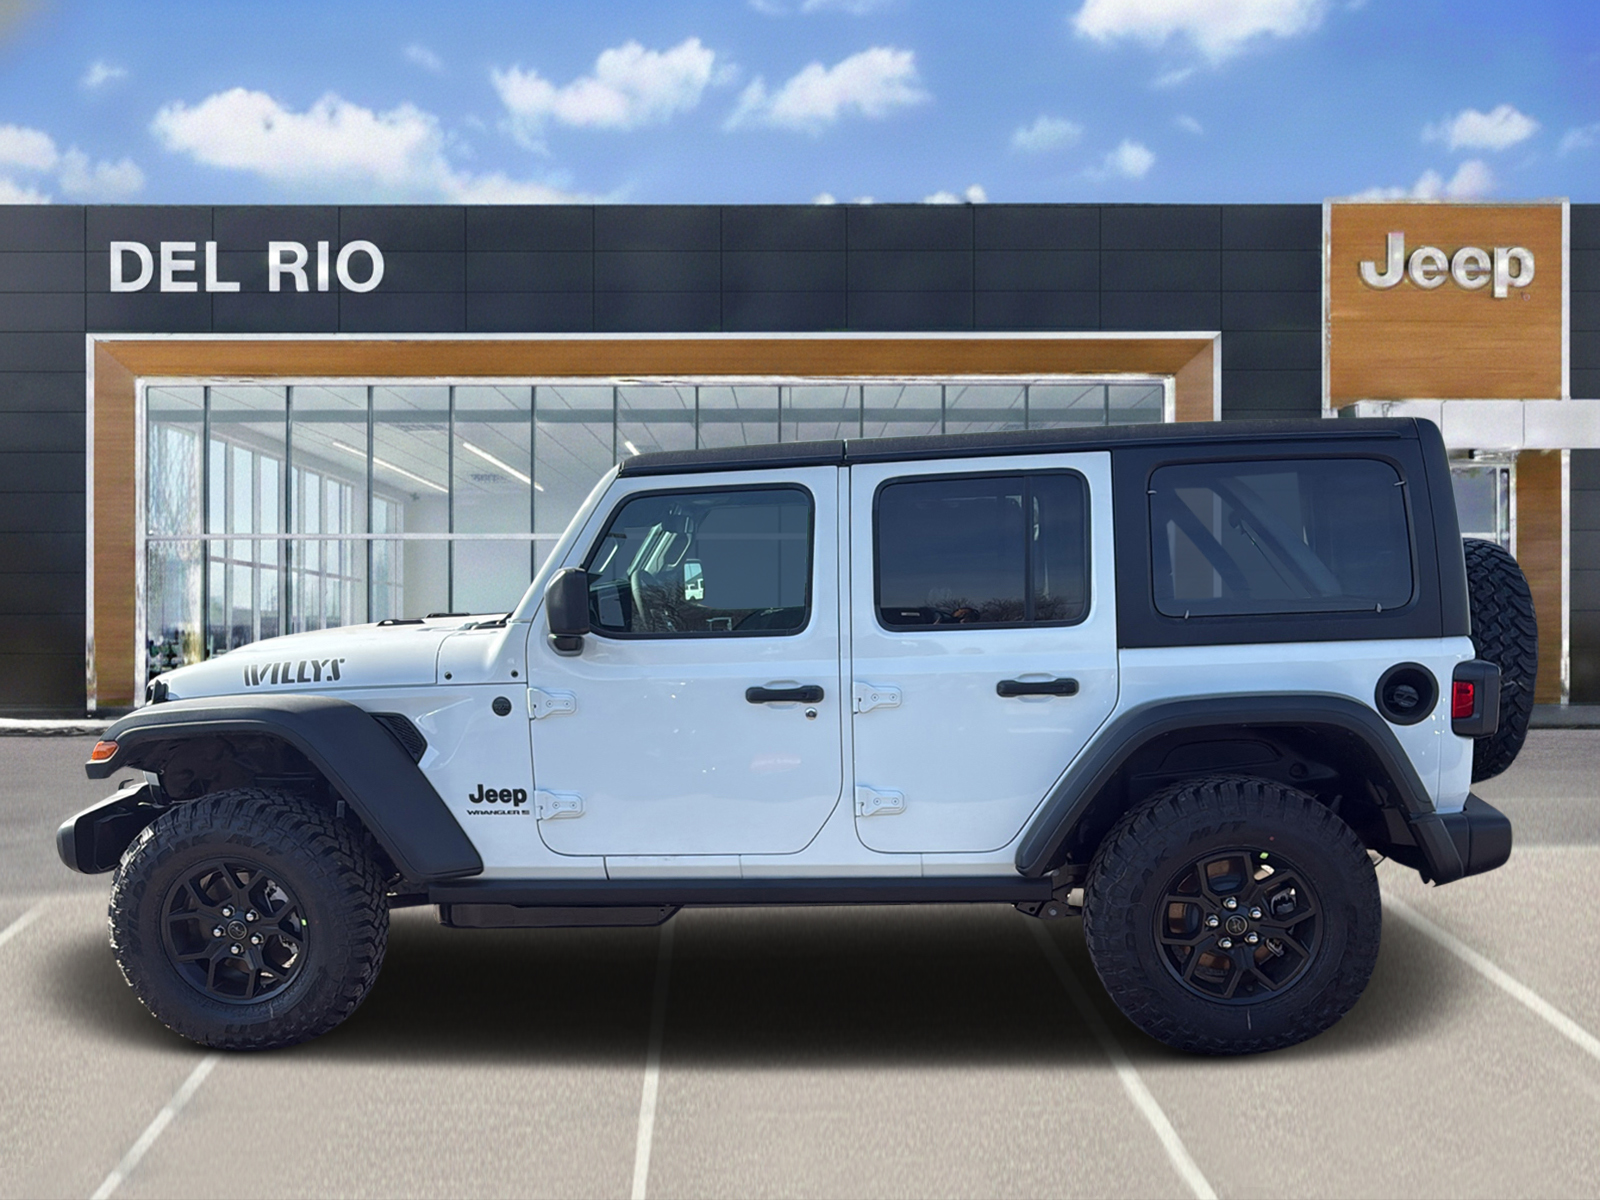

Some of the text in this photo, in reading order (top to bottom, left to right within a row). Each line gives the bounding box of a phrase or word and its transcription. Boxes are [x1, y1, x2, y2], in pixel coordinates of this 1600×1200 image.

[109, 239, 385, 294] DEL RIO
[1359, 231, 1536, 299] Jeep
[243, 657, 346, 687] WILLYS
[468, 783, 527, 807] Jeep
